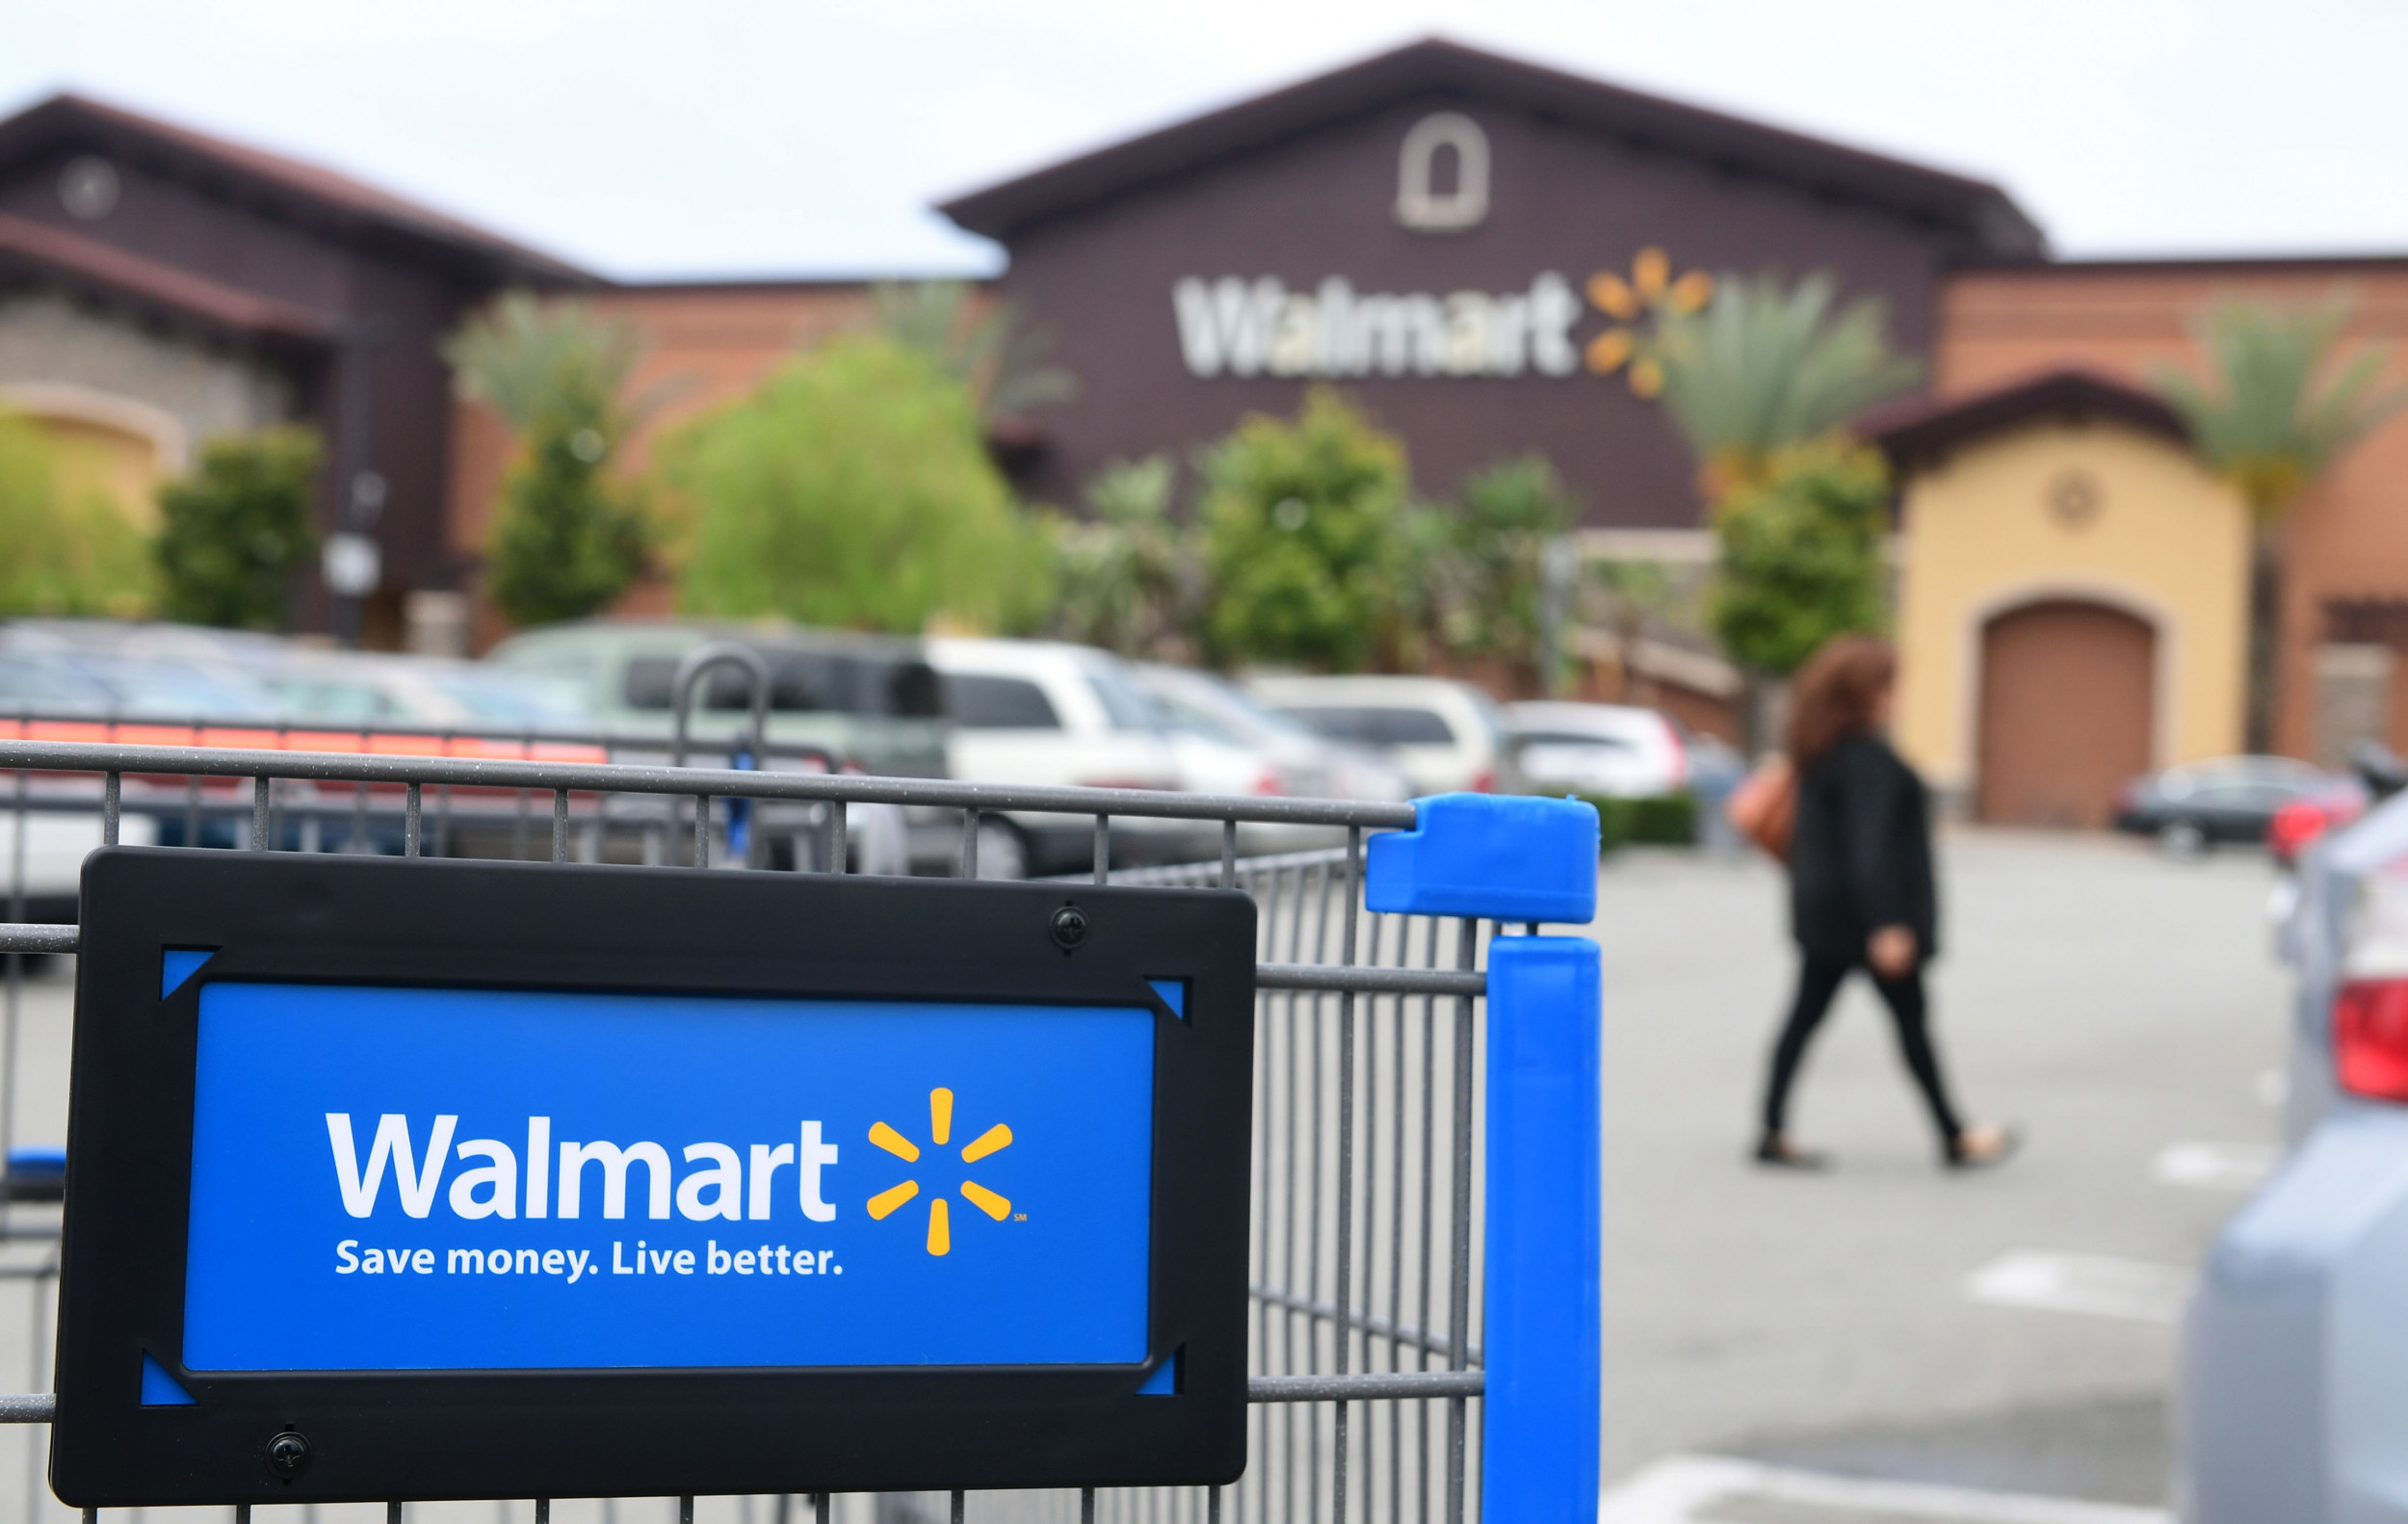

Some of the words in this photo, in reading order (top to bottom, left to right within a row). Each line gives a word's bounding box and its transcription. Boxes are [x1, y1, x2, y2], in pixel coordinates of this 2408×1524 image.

[1173, 273, 1581, 377] Walmart
[326, 1113, 838, 1222] Walmart
[1013, 1213, 1028, 1222] SM
[335, 1240, 435, 1274] Save
[447, 1248, 599, 1284] money.
[613, 1240, 696, 1275] Live
[707, 1240, 843, 1275] better.
